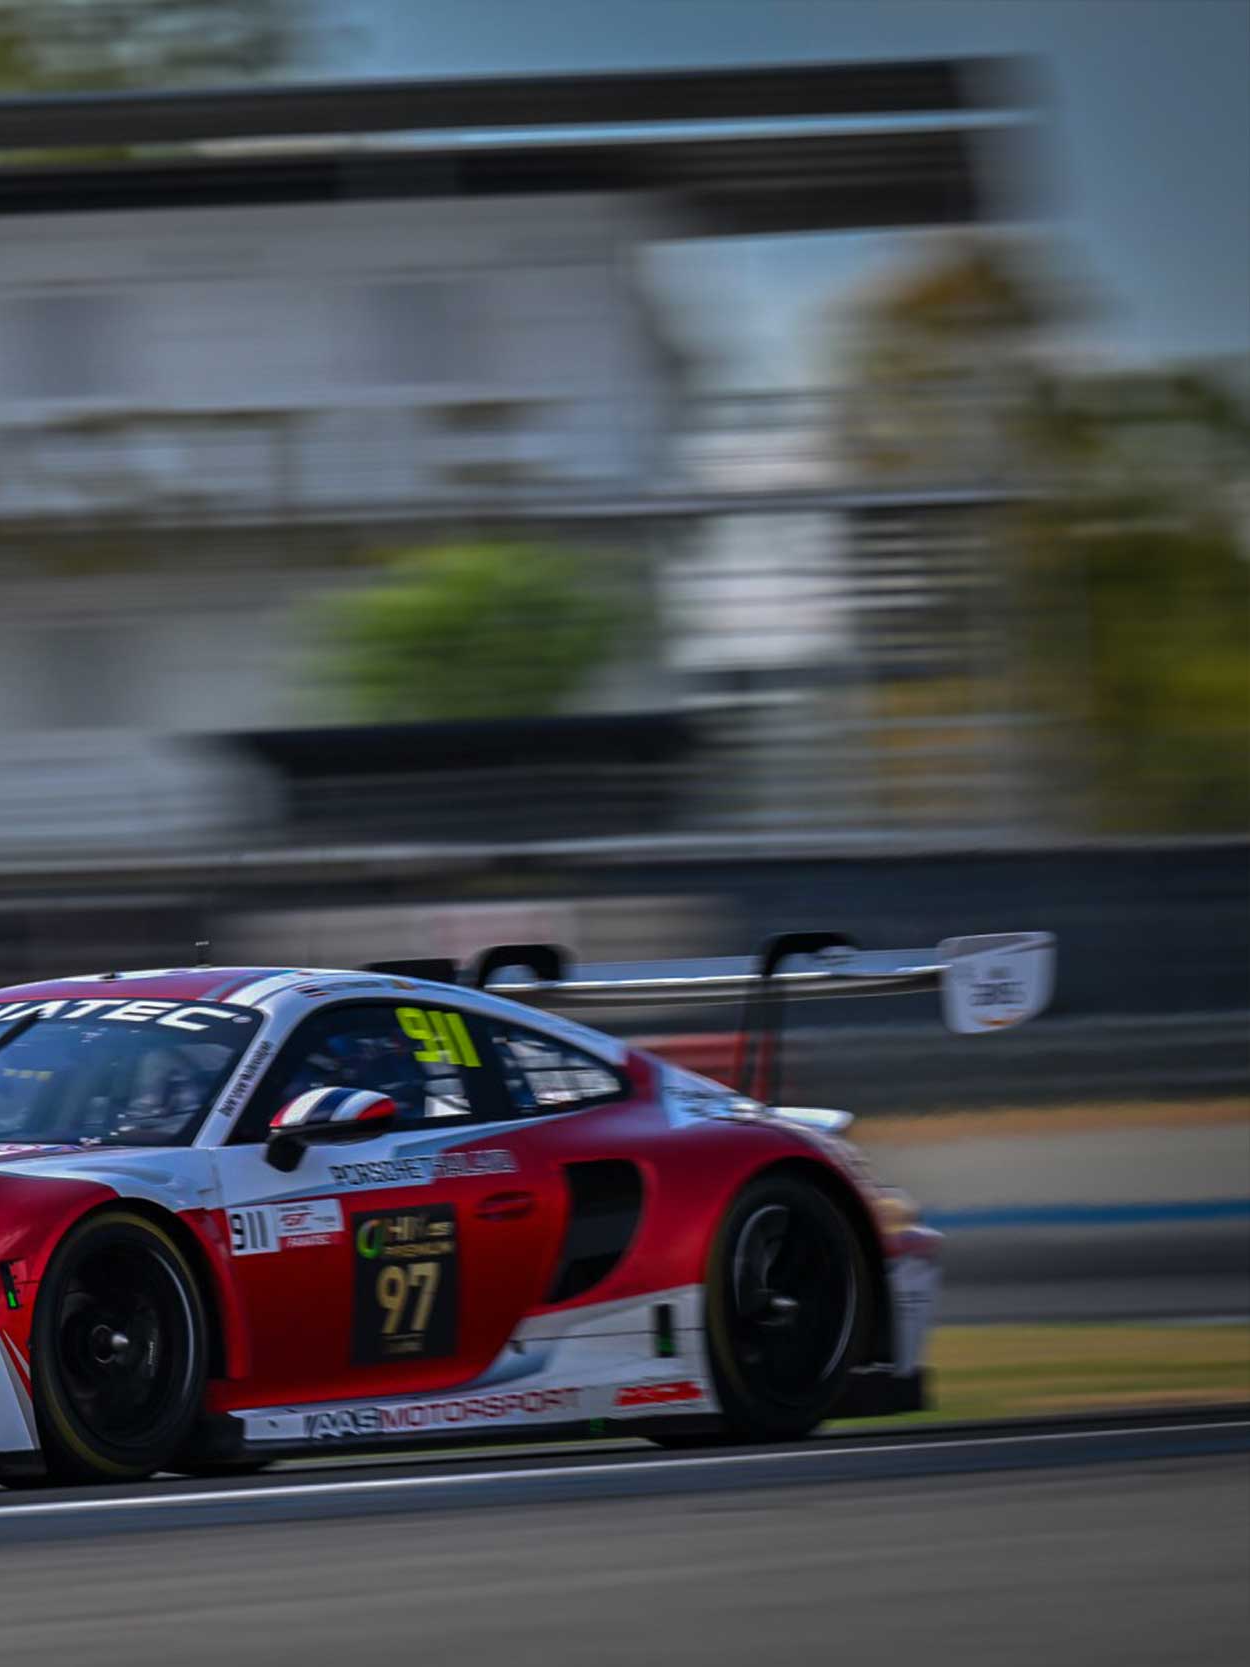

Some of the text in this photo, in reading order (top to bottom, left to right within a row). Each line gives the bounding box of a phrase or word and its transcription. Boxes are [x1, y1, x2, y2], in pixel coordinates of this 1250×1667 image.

[395, 1007, 482, 1068] 911
[328, 1156, 421, 1187] PORSCHE
[230, 1210, 269, 1251] 911
[376, 1258, 441, 1334] 97
[377, 1386, 583, 1428] MOTORSPORT
